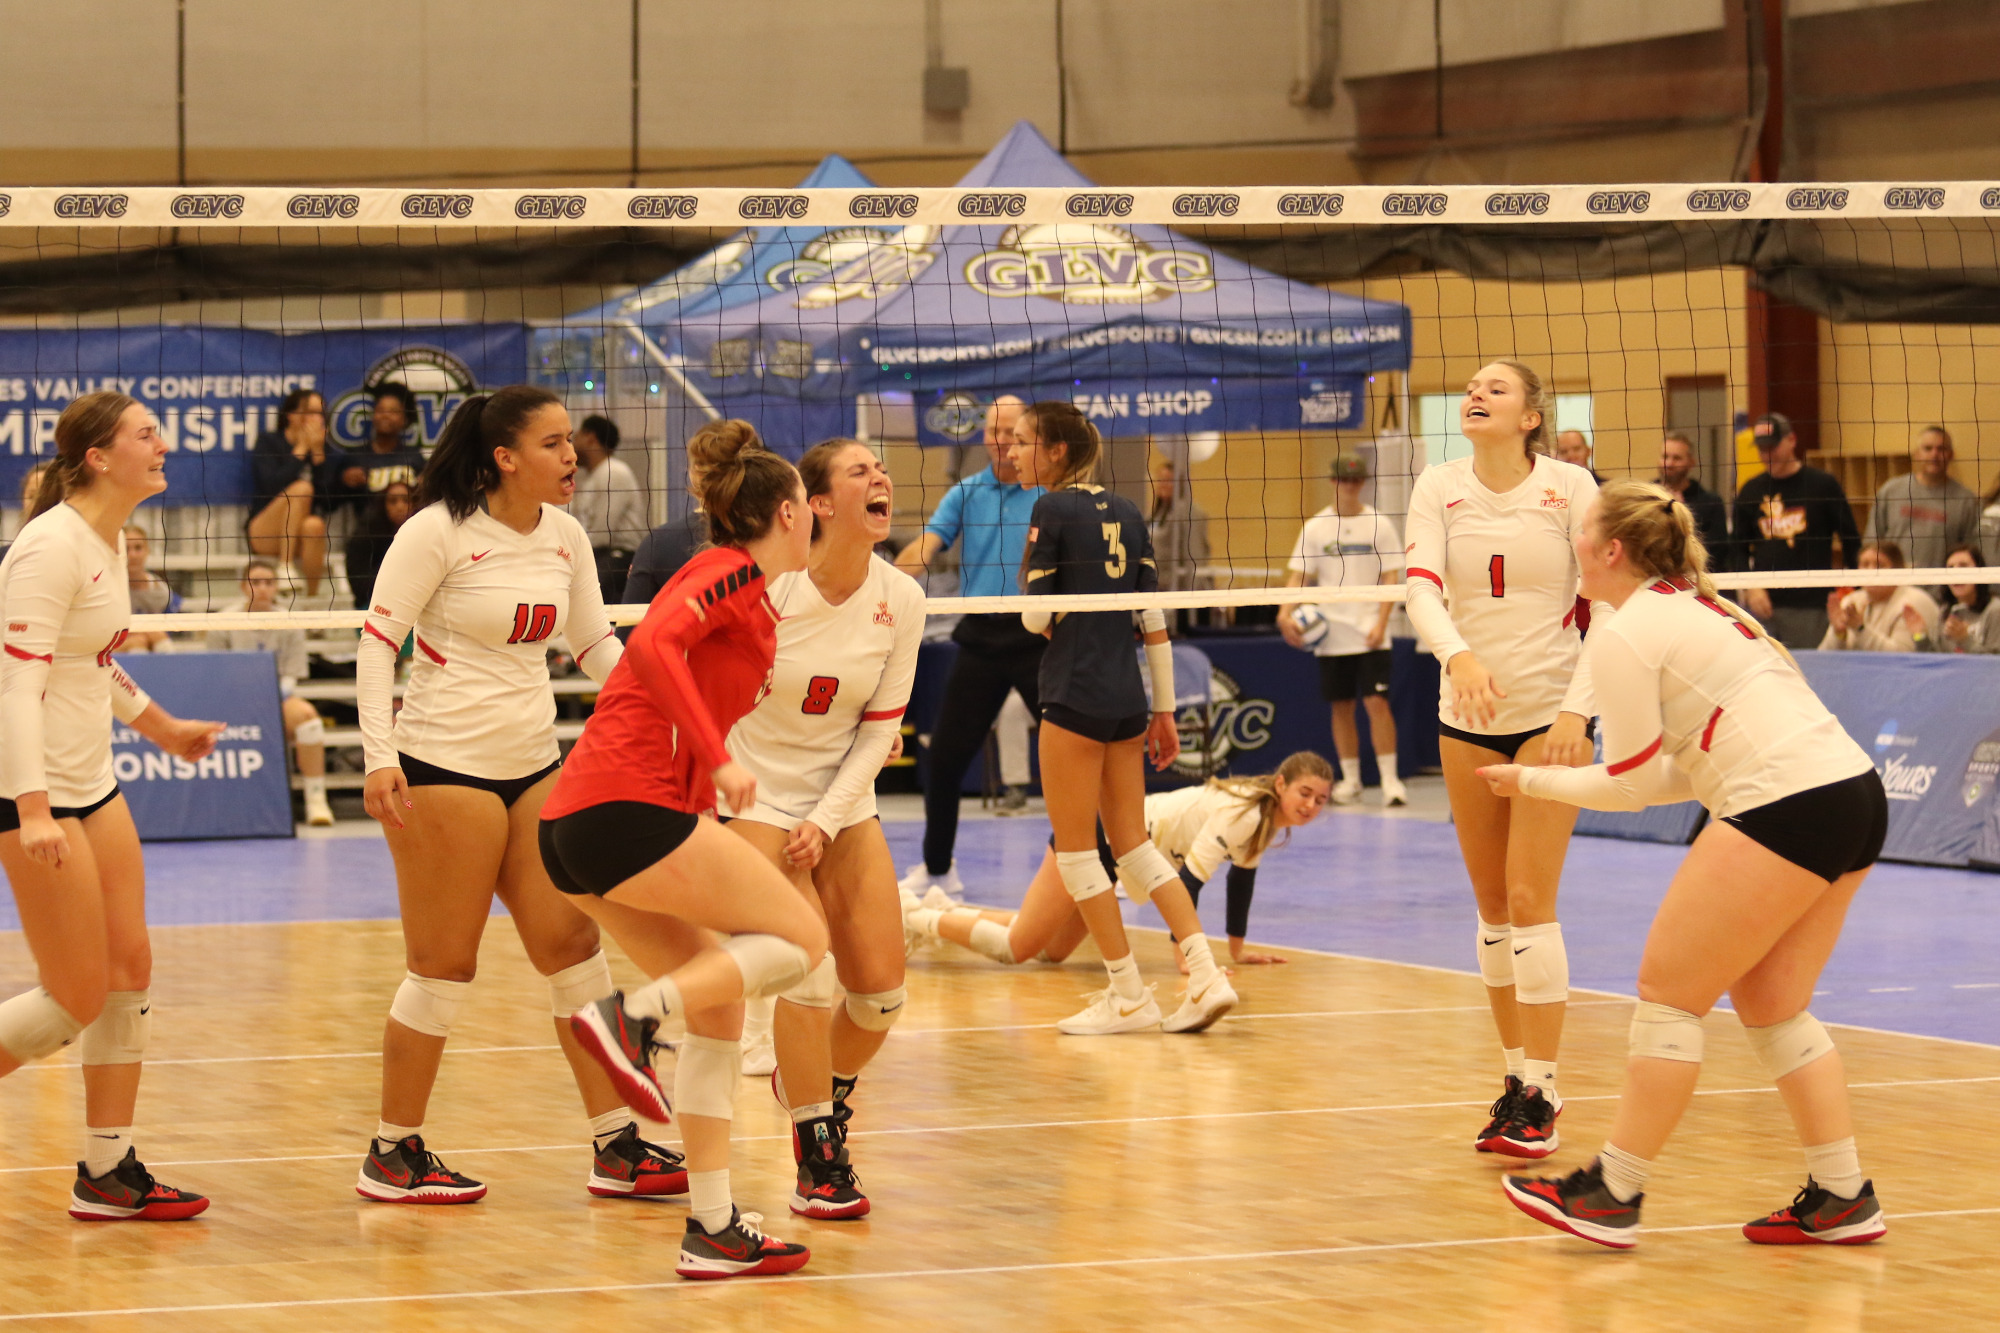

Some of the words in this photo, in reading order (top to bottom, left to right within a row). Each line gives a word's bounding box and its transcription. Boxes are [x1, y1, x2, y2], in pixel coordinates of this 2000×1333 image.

[54, 194, 128, 218] GLVC
[171, 195, 245, 218] GLVC
[287, 195, 359, 218] GLVC
[401, 195, 474, 218] GLVC
[515, 195, 586, 219] GLVC
[628, 196, 698, 219] GLVC
[739, 196, 809, 219] GLVC
[849, 195, 919, 218] GLVC
[958, 194, 1026, 217] GLVC
[1066, 194, 1134, 217] GLVC
[1173, 194, 1240, 216] GLVC
[1277, 194, 1344, 216] GLVC
[1382, 193, 1448, 216] GLVC
[1485, 193, 1550, 215] GLVC
[1586, 191, 1650, 214] GLVC
[1687, 190, 1751, 212] GLVC
[1786, 189, 1849, 210] GLVC
[1884, 188, 1946, 209] GLVC
[965, 250, 1218, 297] GLVC
[141, 374, 316, 399] CONFERENCE
[1074, 394, 1129, 419] FAN
[1136, 391, 1213, 418] SHOP
[1101, 521, 1127, 579] 3
[1488, 554, 1505, 598] 1
[506, 603, 557, 644] 10
[801, 676, 839, 715] 8
